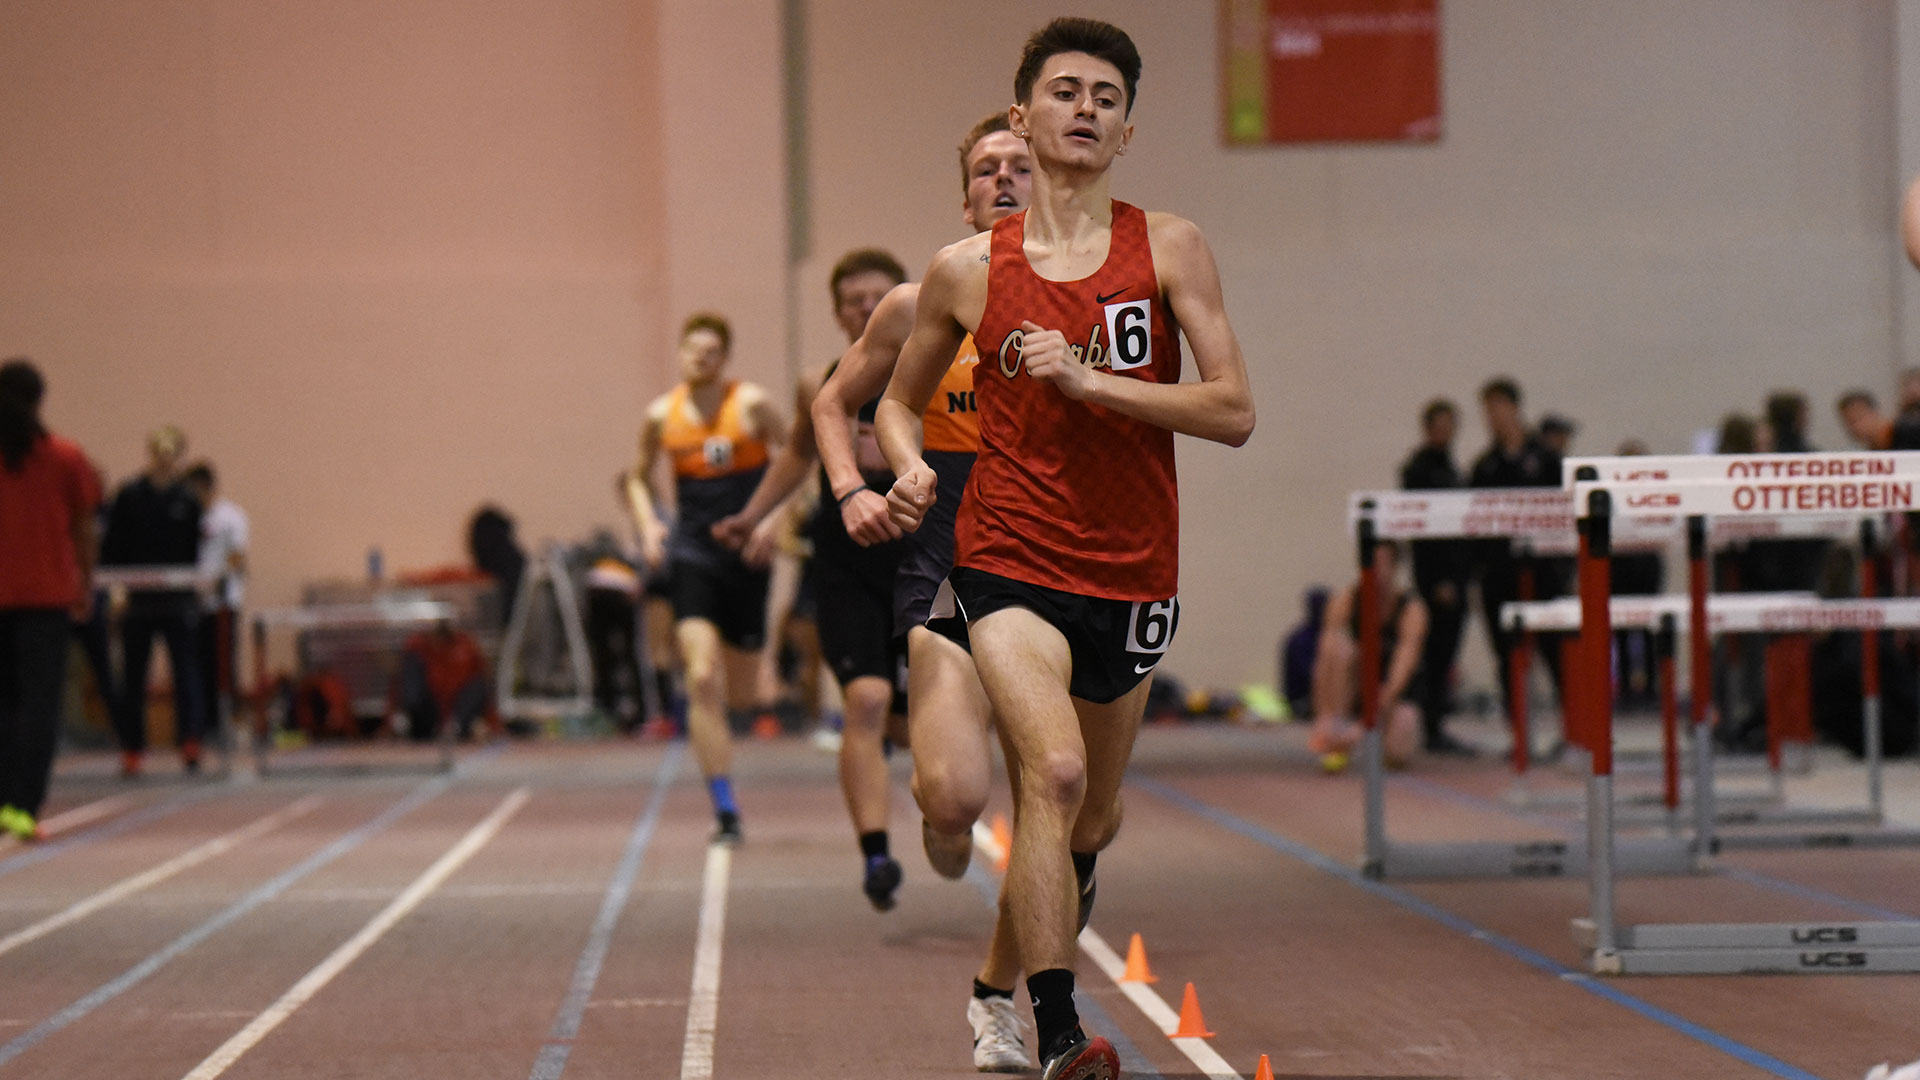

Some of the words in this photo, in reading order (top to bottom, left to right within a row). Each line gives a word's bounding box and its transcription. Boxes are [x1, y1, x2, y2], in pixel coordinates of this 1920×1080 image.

[1115, 306, 1148, 364] 6
[1727, 459, 1895, 479] OTTERBEIN
[1626, 493, 1681, 507] UCS
[1732, 482, 1913, 511] OTTERBEIN
[1135, 600, 1170, 650] 6
[1790, 927, 1857, 943] UCS
[1800, 952, 1868, 967] UCS
